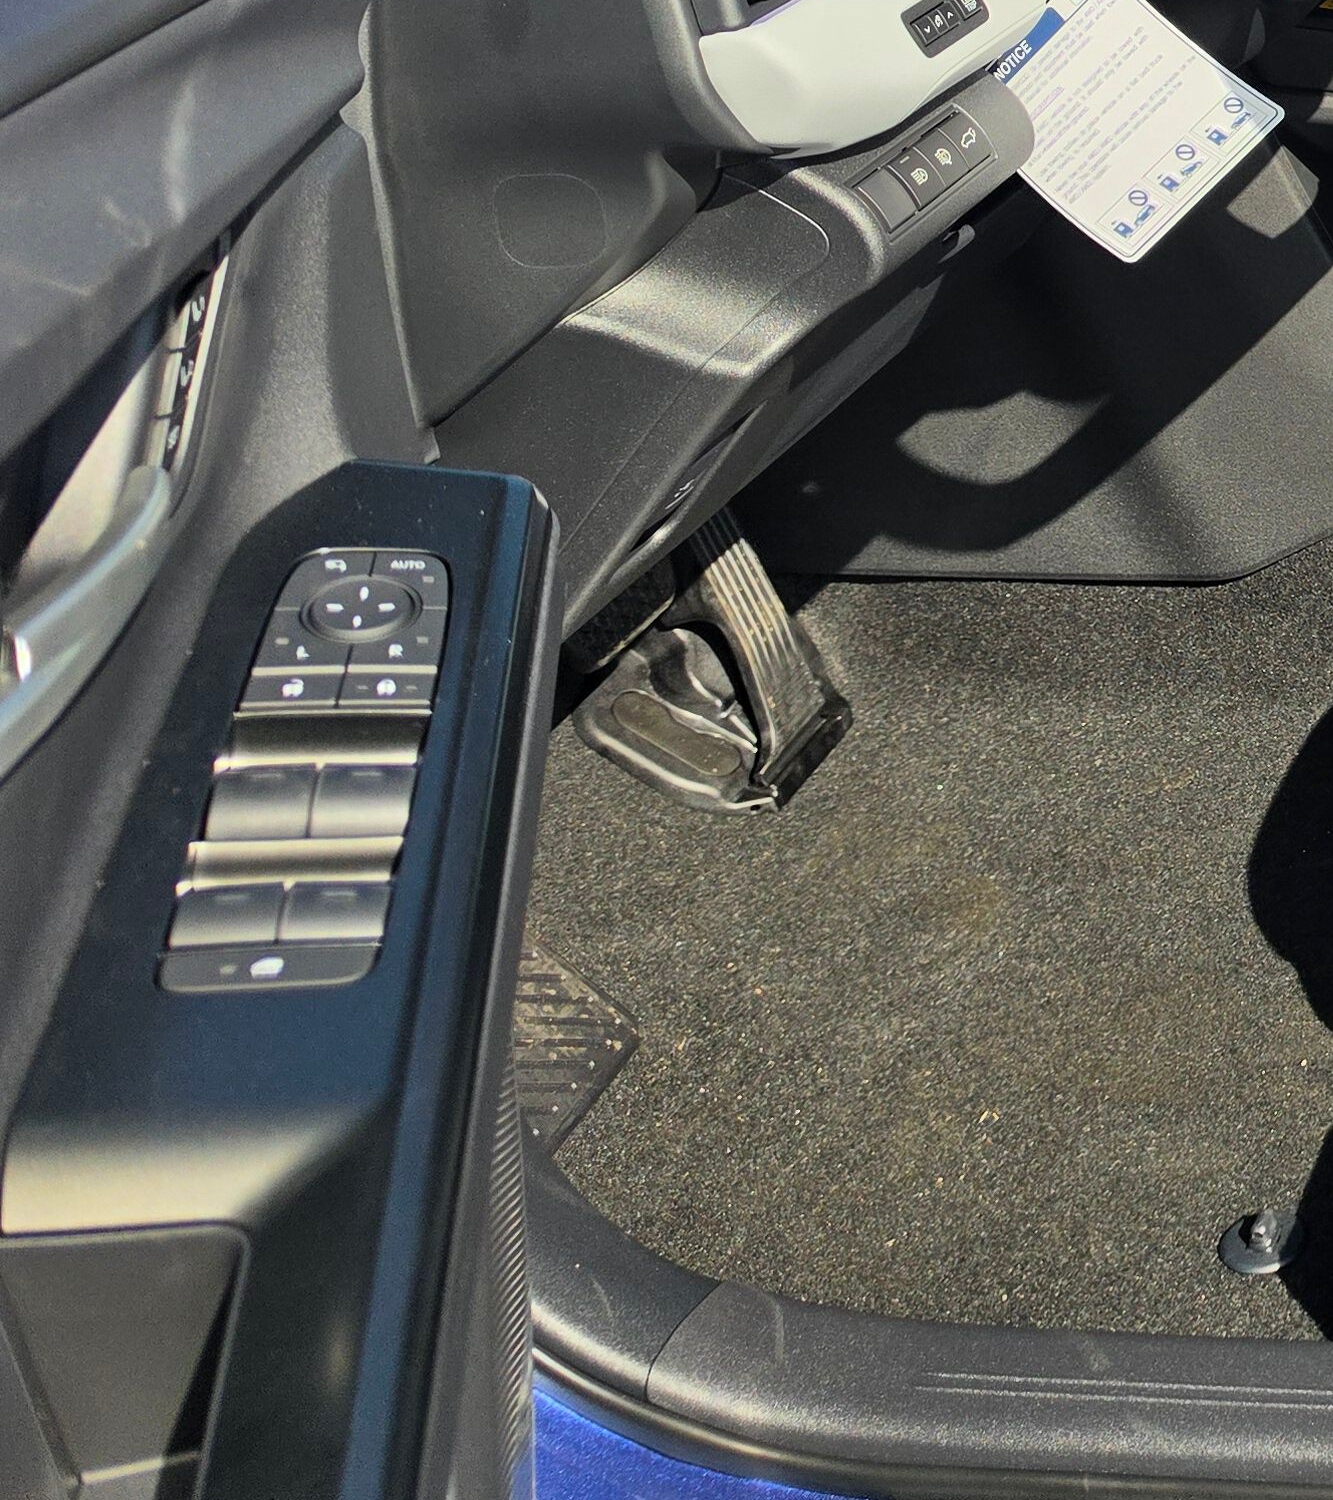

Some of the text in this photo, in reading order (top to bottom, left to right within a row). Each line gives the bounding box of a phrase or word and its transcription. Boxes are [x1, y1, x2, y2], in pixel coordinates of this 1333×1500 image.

[993, 38, 1033, 82] NOTICE
[389, 559, 427, 572] AUTO
[388, 643, 405, 660] R
